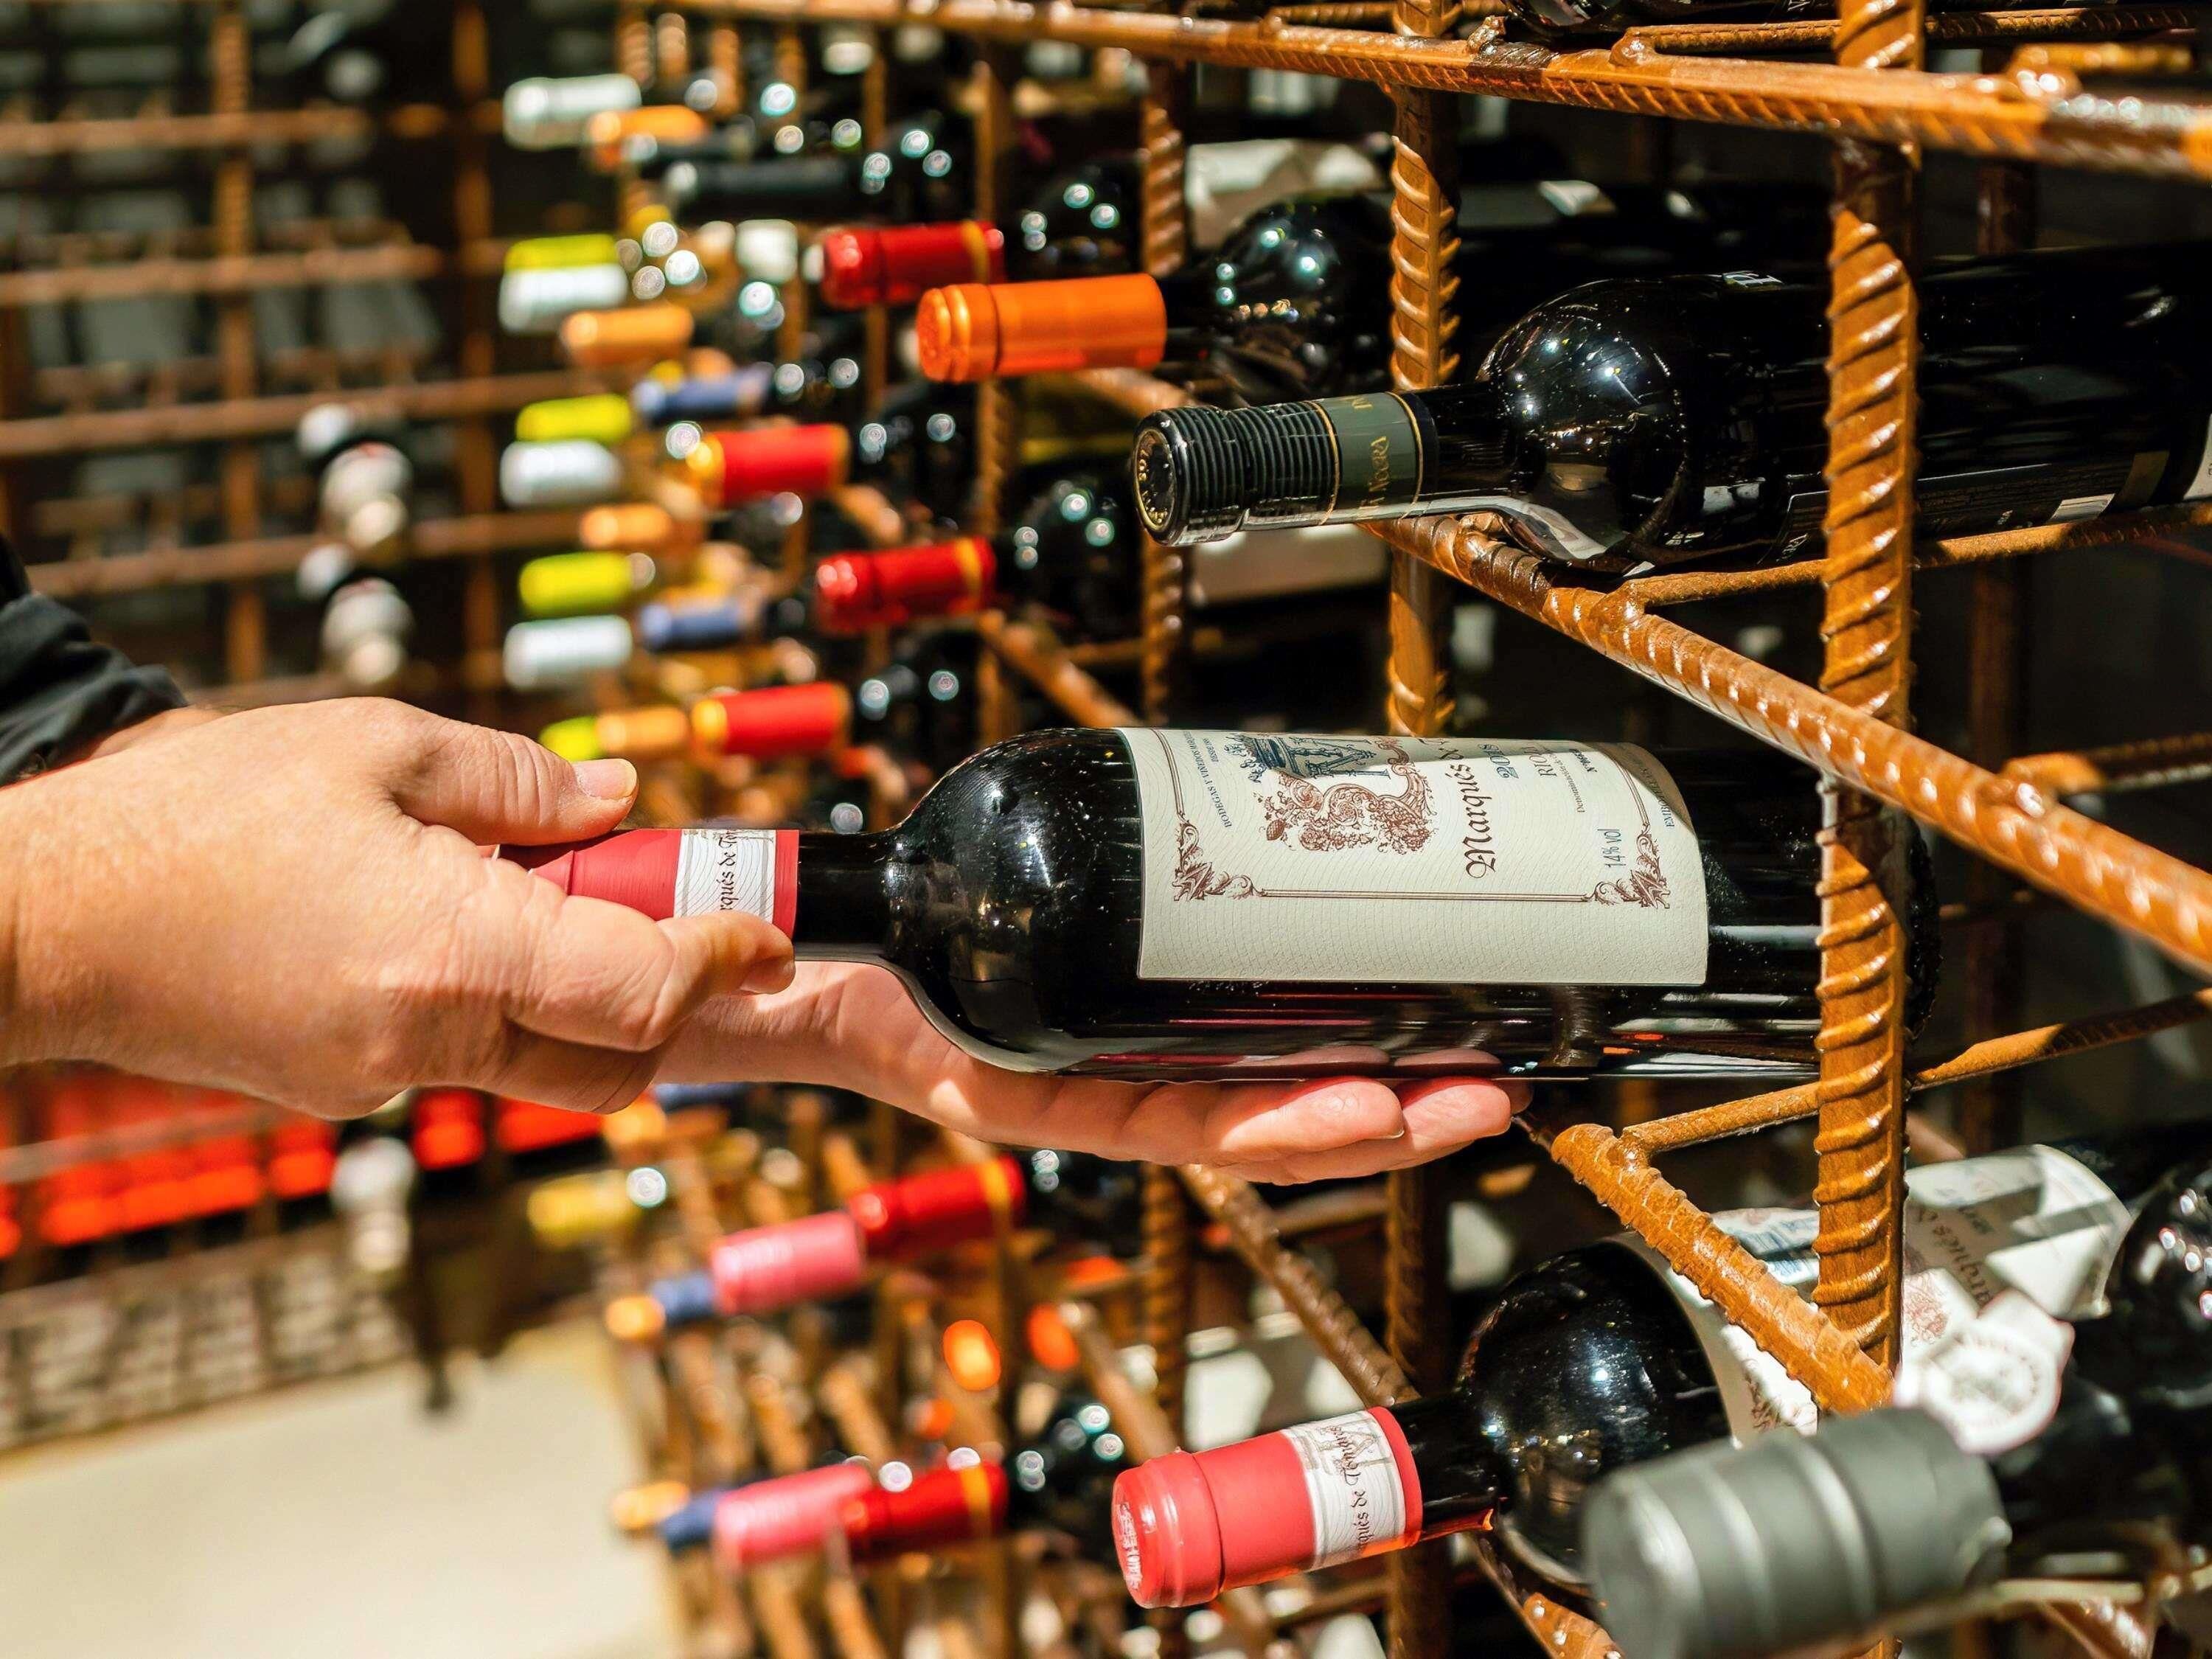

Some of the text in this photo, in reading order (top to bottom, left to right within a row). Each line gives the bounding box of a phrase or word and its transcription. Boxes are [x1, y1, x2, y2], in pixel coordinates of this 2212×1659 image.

[1208, 786, 1233, 828] BODEGAS
[1444, 763, 1496, 879] Marqués
[717, 852, 737, 866] de
[1597, 829, 1627, 868] 14% vol
[715, 872, 738, 911] rqués
[1350, 1491, 1367, 1508] de
